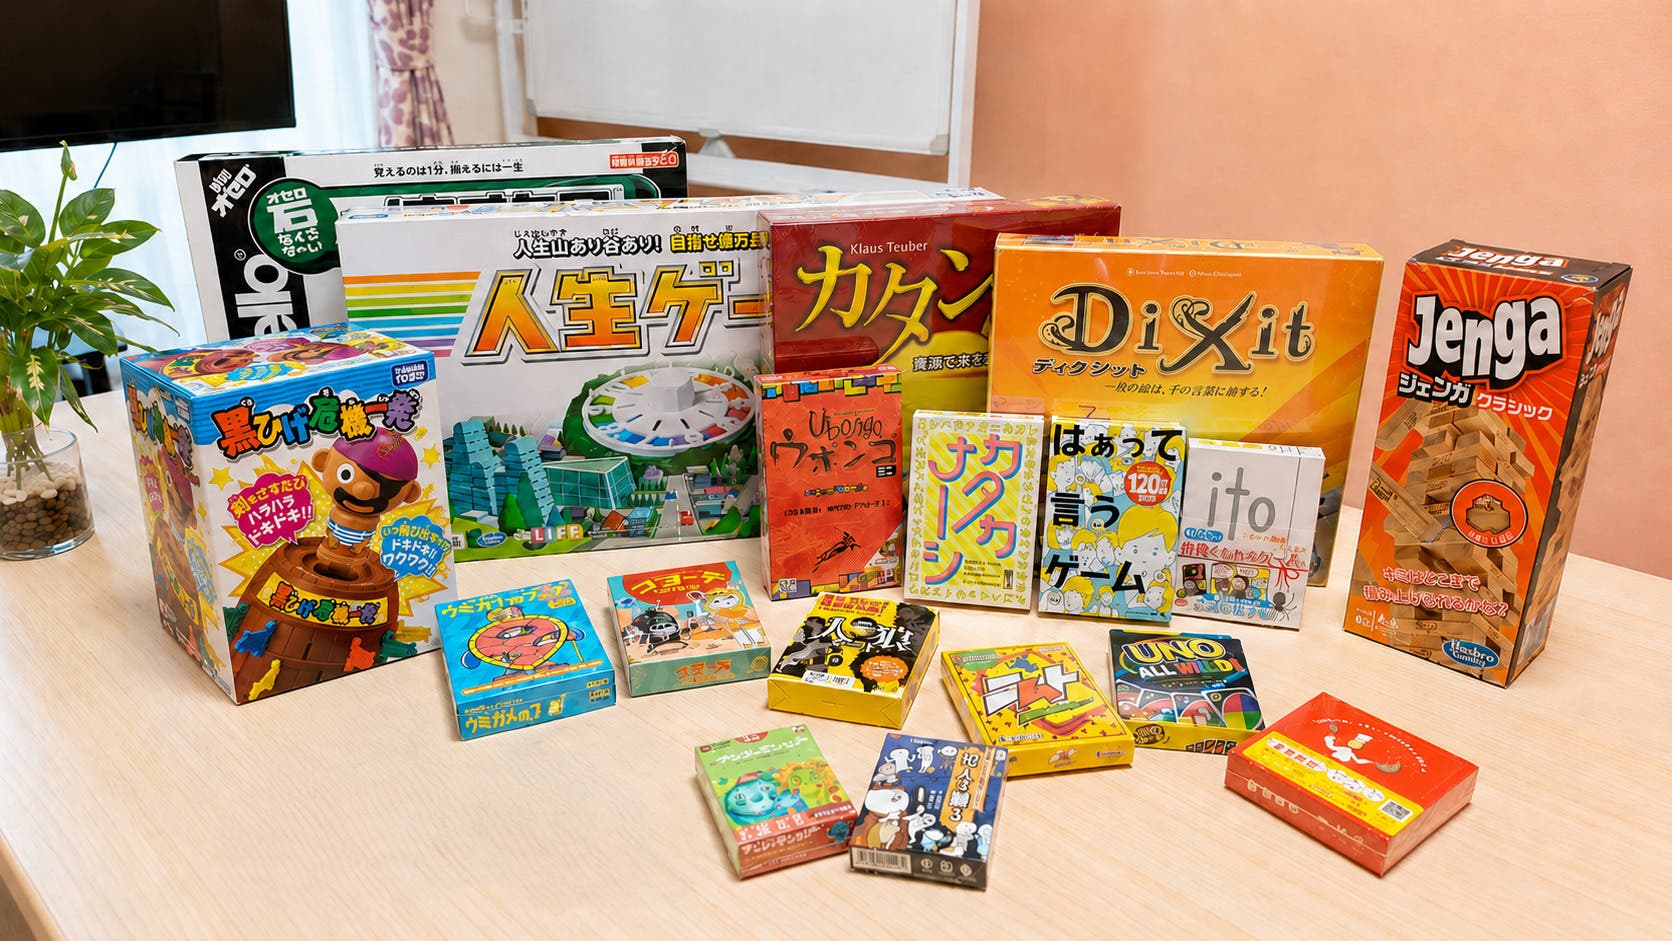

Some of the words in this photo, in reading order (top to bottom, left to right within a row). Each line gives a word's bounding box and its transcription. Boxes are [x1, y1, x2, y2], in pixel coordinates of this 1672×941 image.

[211, 164, 257, 218] オセロ
[266, 187, 308, 204] オセロ
[850, 243, 884, 255] Klaus
[886, 241, 928, 253] Teuber
[1447, 246, 1565, 268] Jenga
[795, 245, 995, 367] カタン
[1407, 295, 1562, 381] Jenga
[1032, 358, 1147, 378] ディクシット
[1398, 371, 1472, 405] ジェンガ
[1476, 392, 1554, 421] クラシック
[1053, 424, 1183, 462] はぁって
[1127, 472, 1161, 495] 120
[248, 494, 296, 526] ハラハラ
[1050, 491, 1120, 528] 言う
[1207, 466, 1276, 541] ito
[247, 505, 313, 546] ドキドキ!!
[1044, 554, 1146, 595] ゲーム
[1121, 637, 1227, 666] UNO
[1138, 665, 1178, 680] ALL
